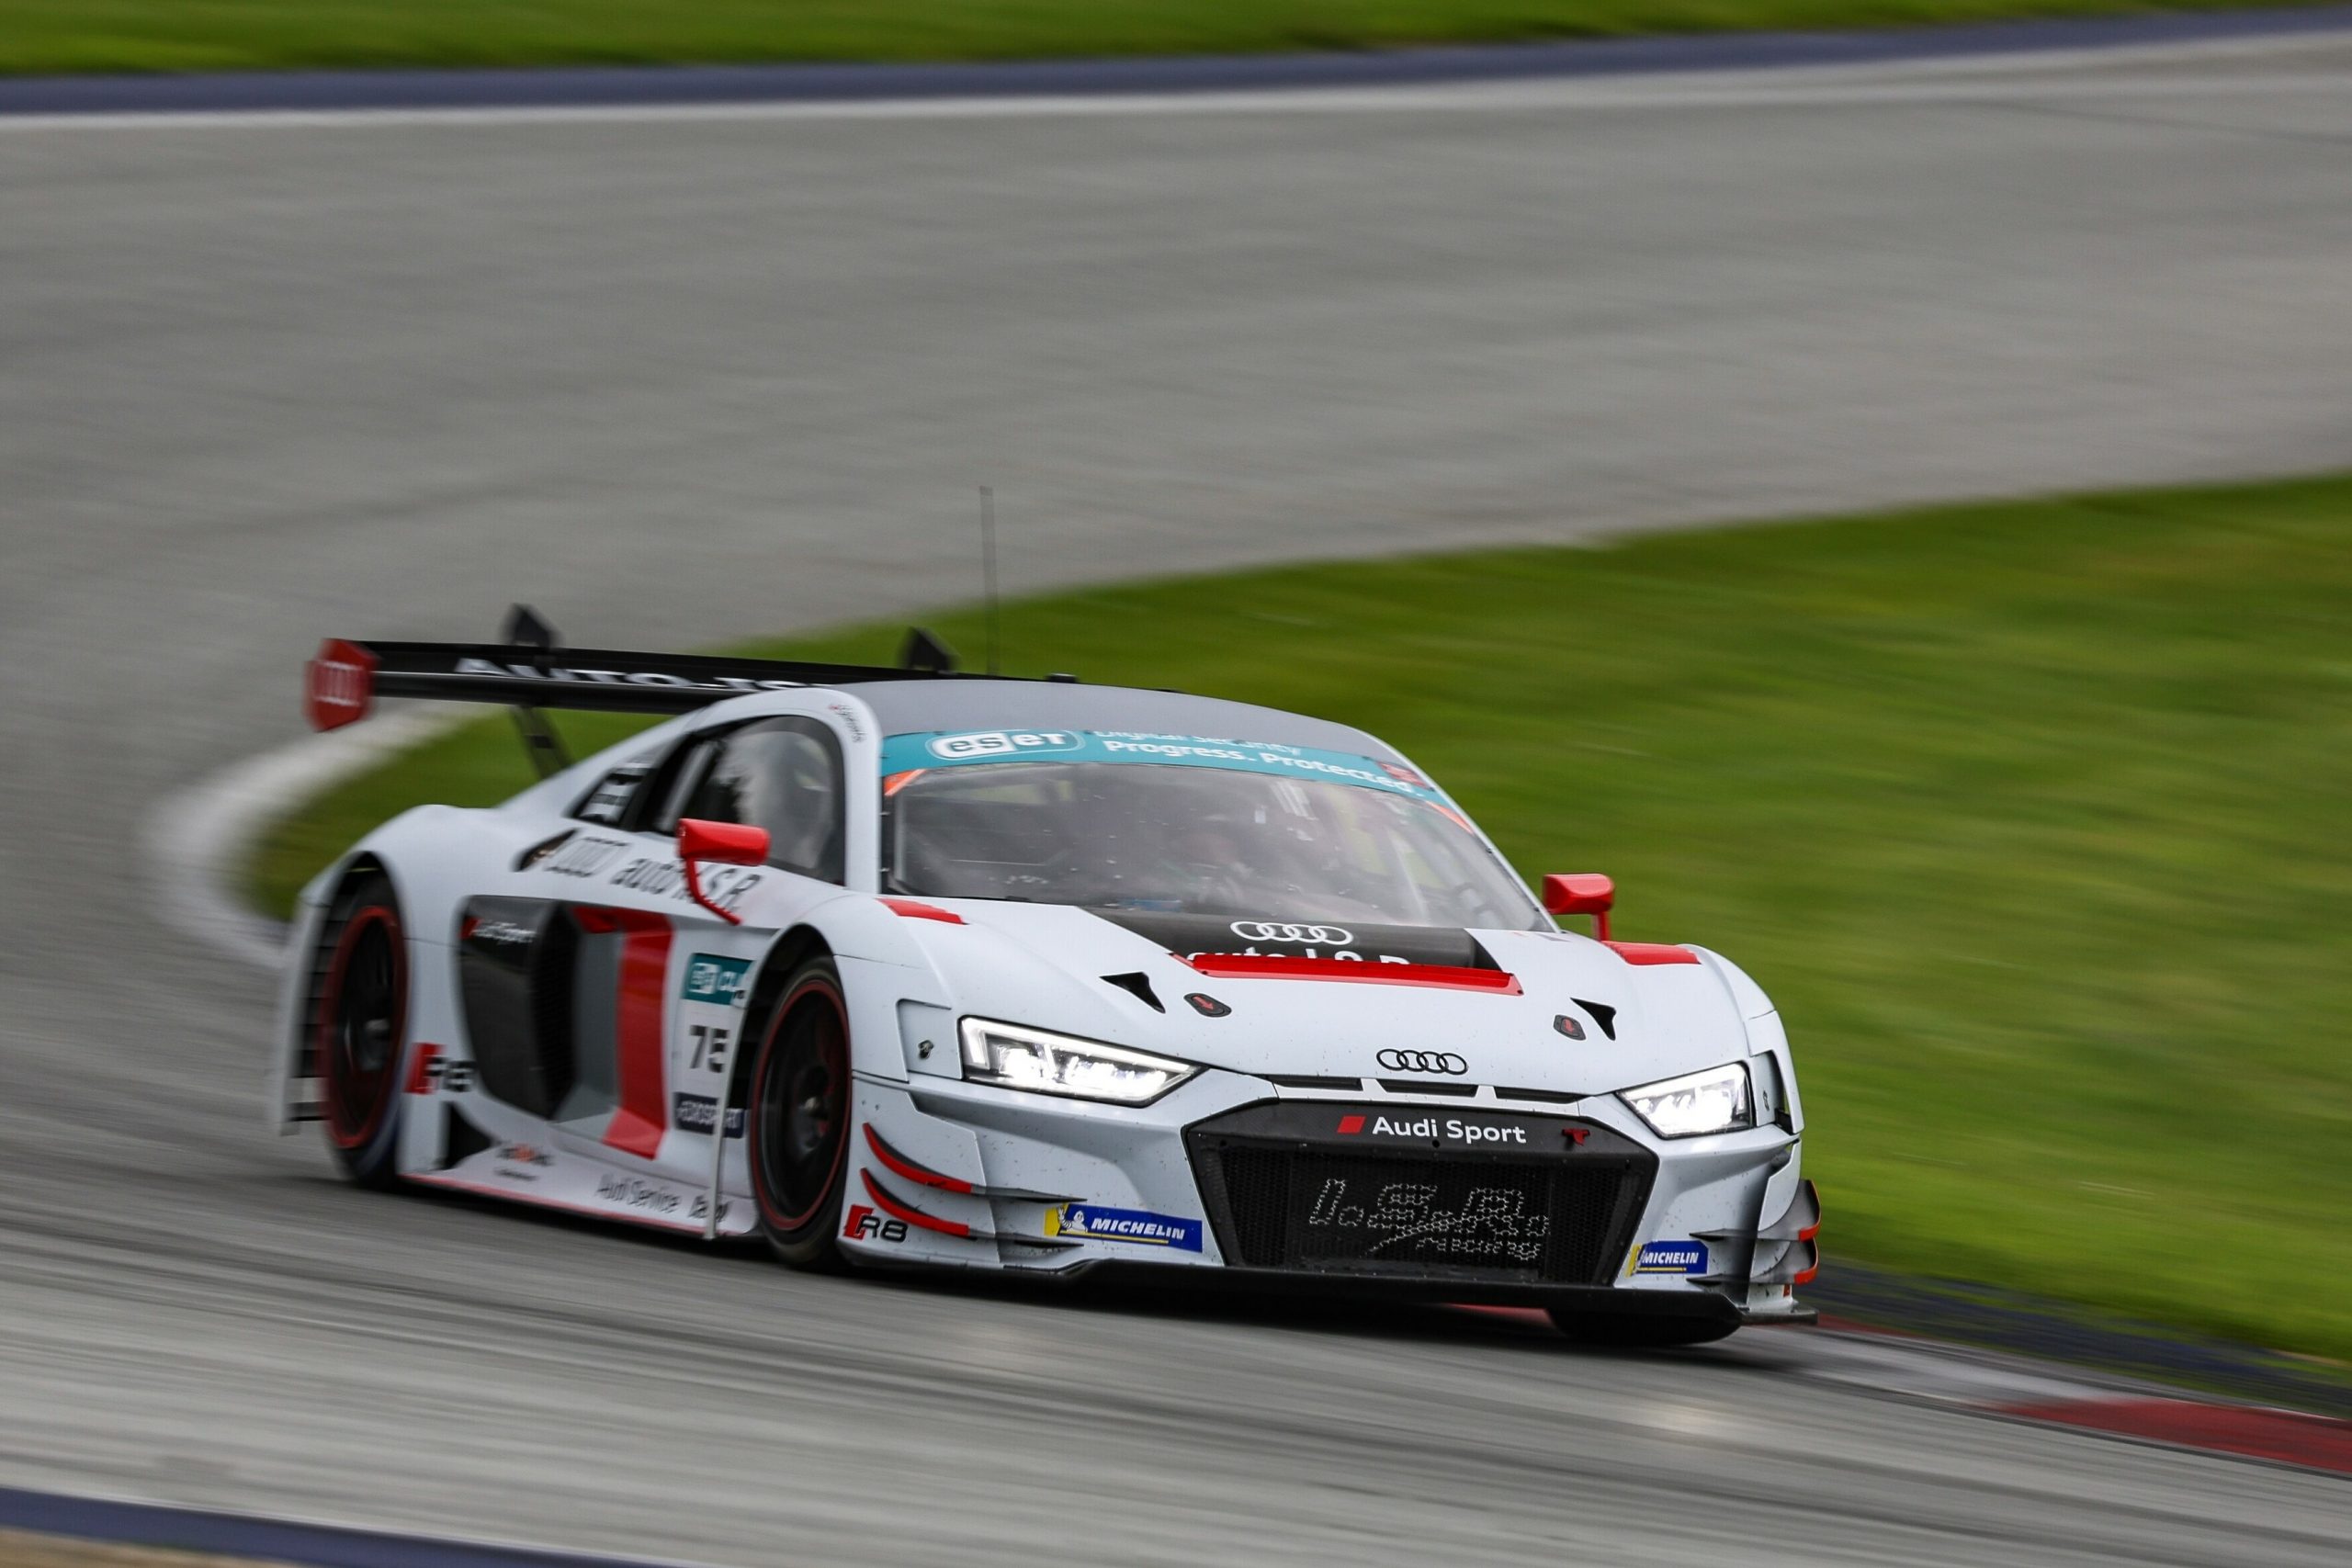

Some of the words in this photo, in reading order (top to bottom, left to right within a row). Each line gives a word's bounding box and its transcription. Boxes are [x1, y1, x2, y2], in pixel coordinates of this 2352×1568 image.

[1102, 739, 1257, 761] Progress.
[1260, 752, 1425, 797] Protected.
[689, 1024, 729, 1074] 75
[1372, 1116, 1438, 1138] Audi
[1445, 1120, 1527, 1144] Sport
[856, 1214, 907, 1243] R8
[1091, 1217, 1186, 1240] MICHELIN
[1642, 1251, 1699, 1264] MICHELIN
